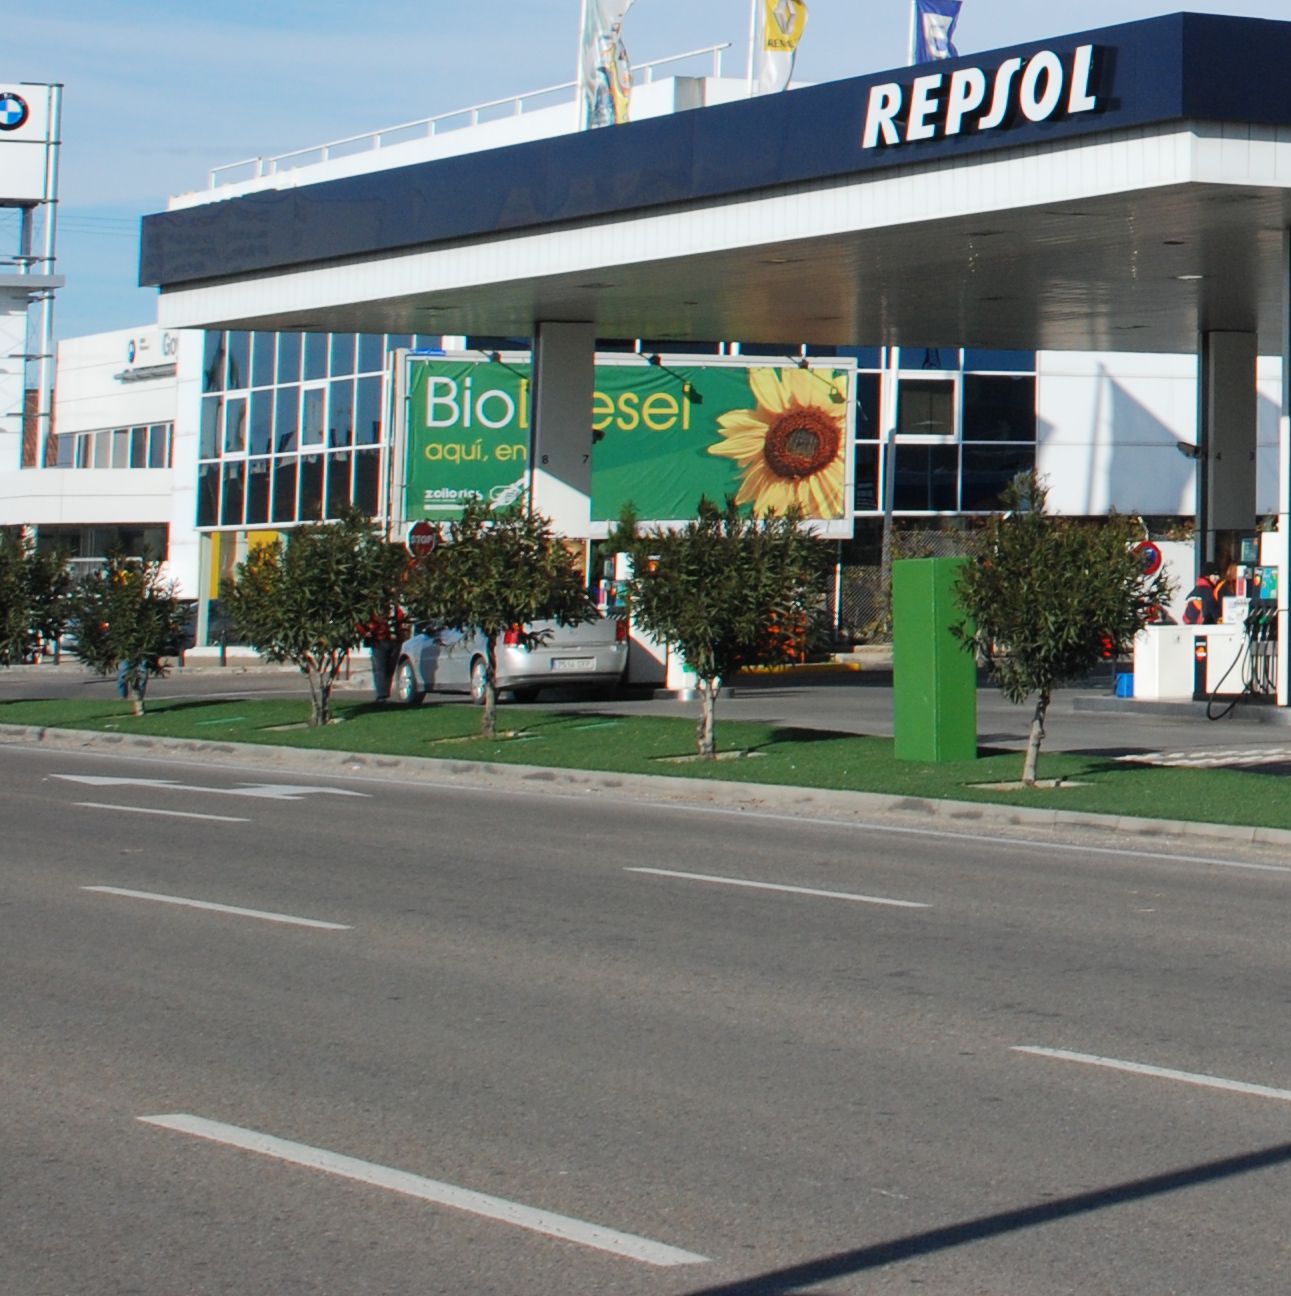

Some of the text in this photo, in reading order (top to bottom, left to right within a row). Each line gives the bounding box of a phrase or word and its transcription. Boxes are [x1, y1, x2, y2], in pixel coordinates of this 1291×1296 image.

[862, 44, 1096, 149] REPSOL
[542, 454, 549, 464] 8
[582, 454, 590, 464] 7
